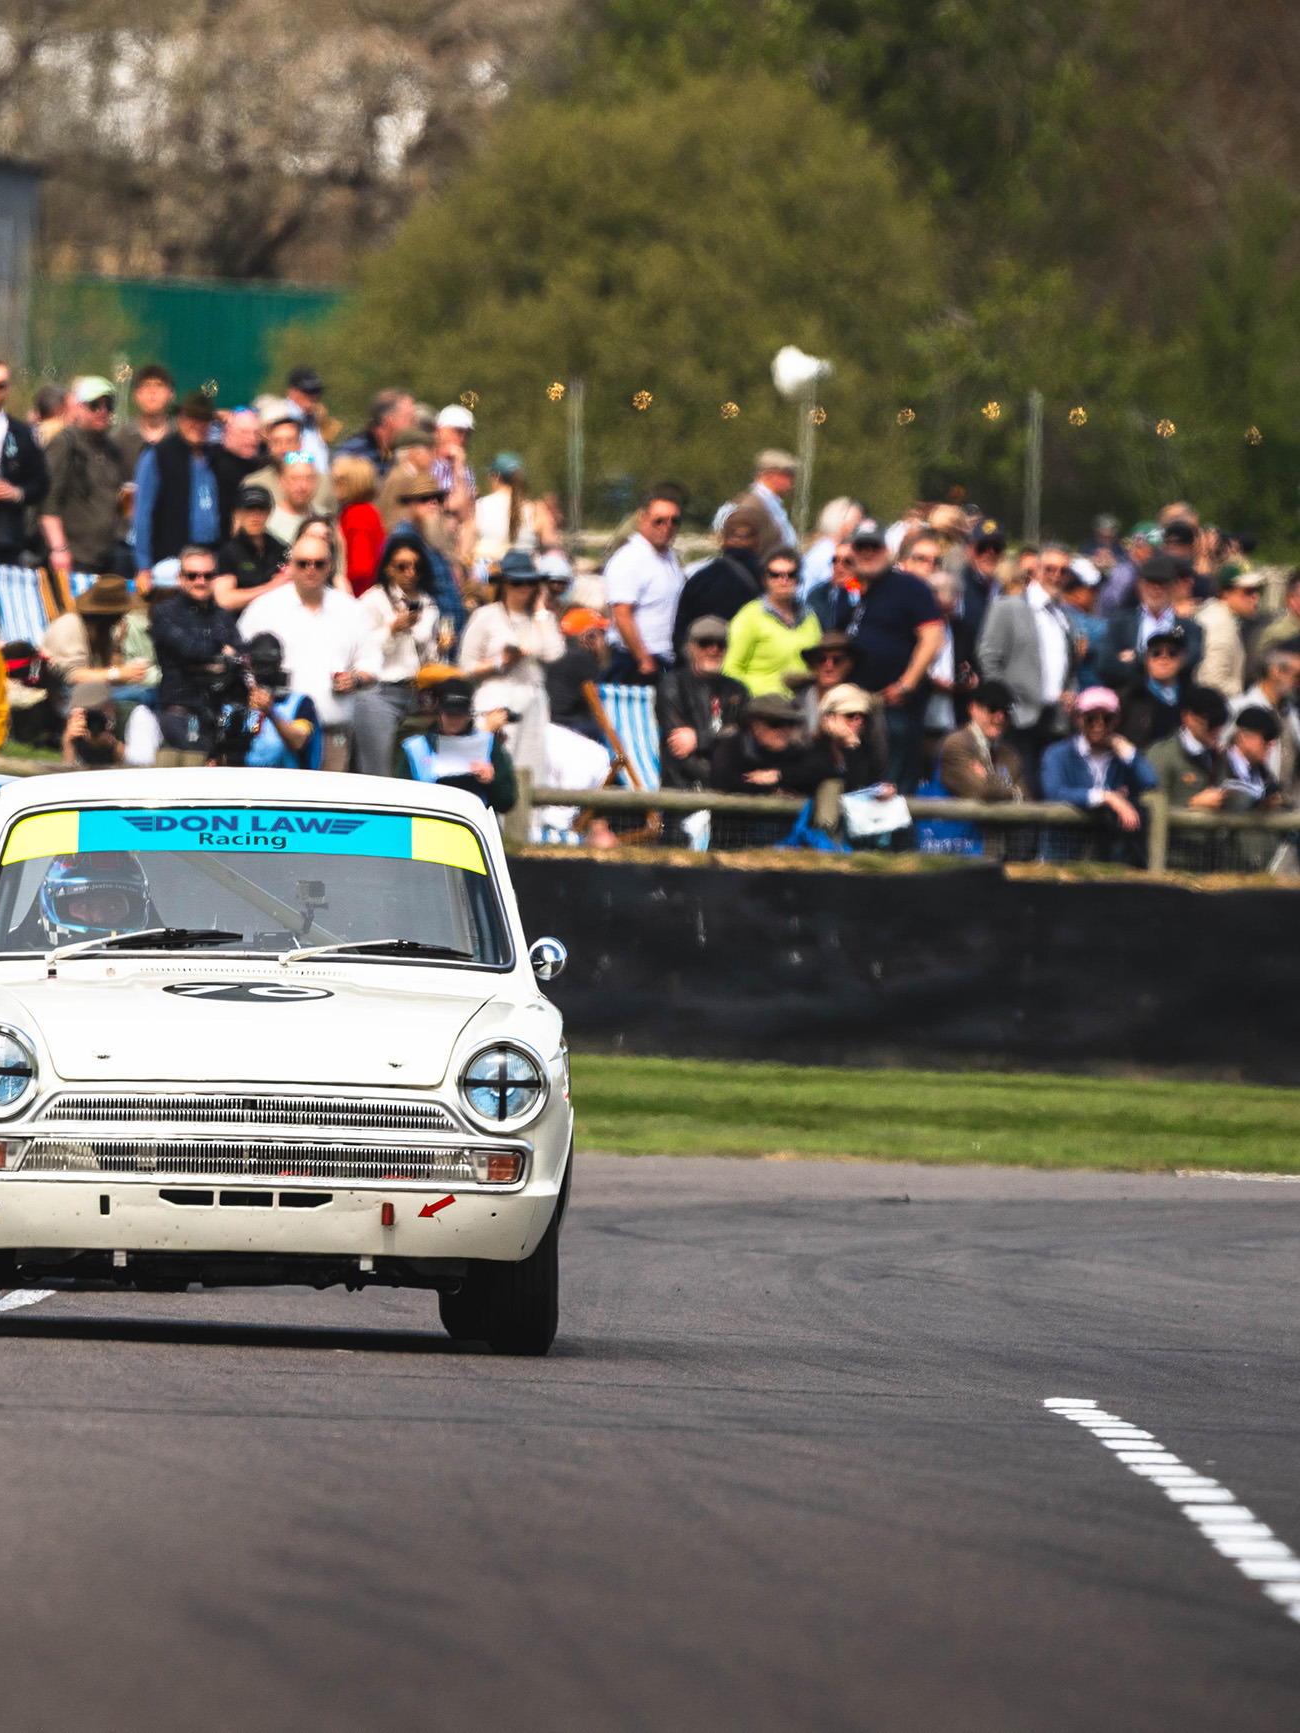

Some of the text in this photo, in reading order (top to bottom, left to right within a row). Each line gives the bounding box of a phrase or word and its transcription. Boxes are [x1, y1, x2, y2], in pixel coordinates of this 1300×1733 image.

[154, 815, 334, 834] DON LAW
[199, 832, 287, 849] Racing
[173, 984, 328, 998] 70
